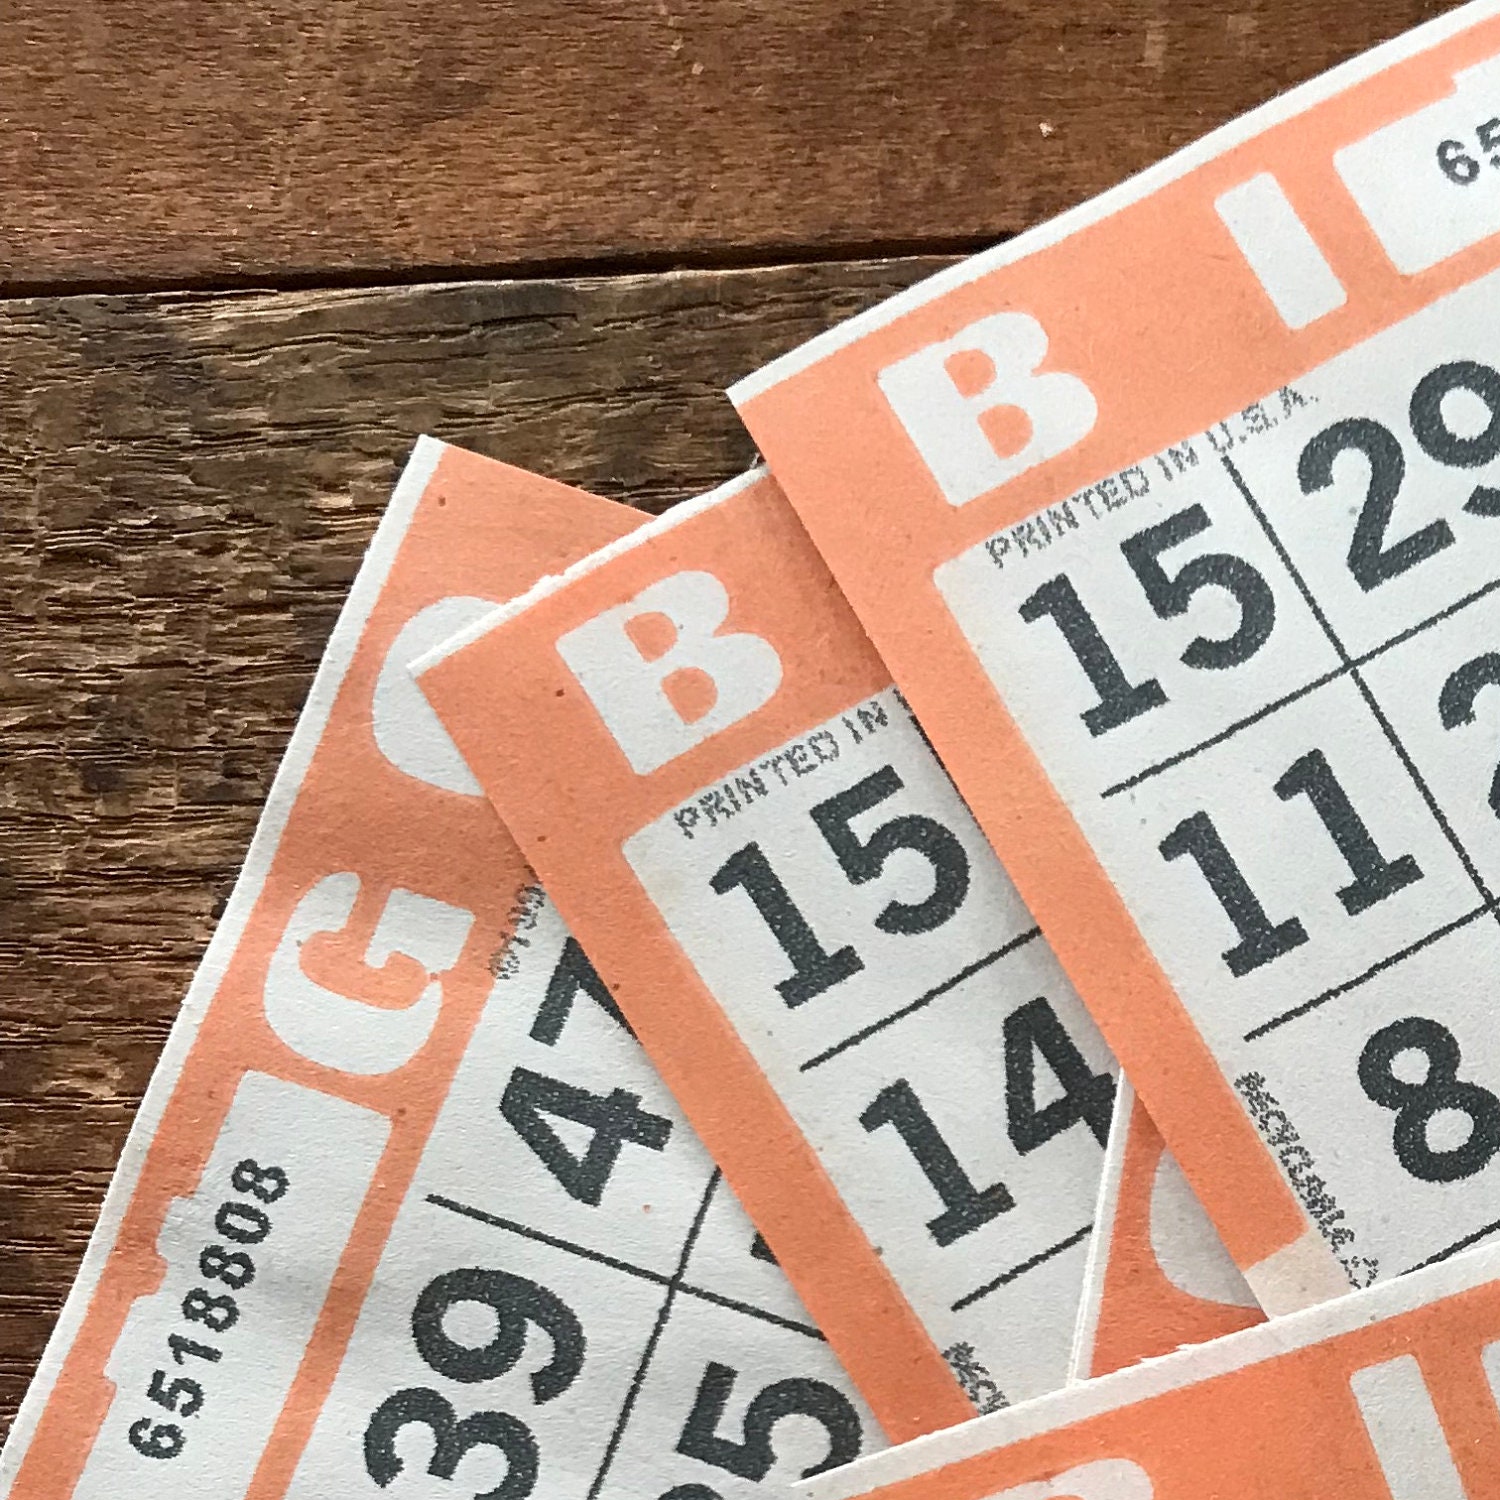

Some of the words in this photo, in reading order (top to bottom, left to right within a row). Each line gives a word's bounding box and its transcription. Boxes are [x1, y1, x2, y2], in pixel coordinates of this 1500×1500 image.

[876, 312, 1098, 506] B
[984, 465, 1151, 569] PRINTED
[1156, 440, 1199, 478] IN
[1203, 384, 1319, 453] U.S.A.
[556, 570, 784, 776] B
[1018, 504, 1275, 737] 15
[673, 731, 839, 838] PRINTED
[843, 701, 890, 743] IN
[1158, 748, 1424, 977] 11
[709, 765, 971, 1009] 15
[859, 997, 1118, 1247] 14
[1234, 1071, 1355, 1253] RECYCLABLE
[128, 1159, 290, 1460] 6518808
